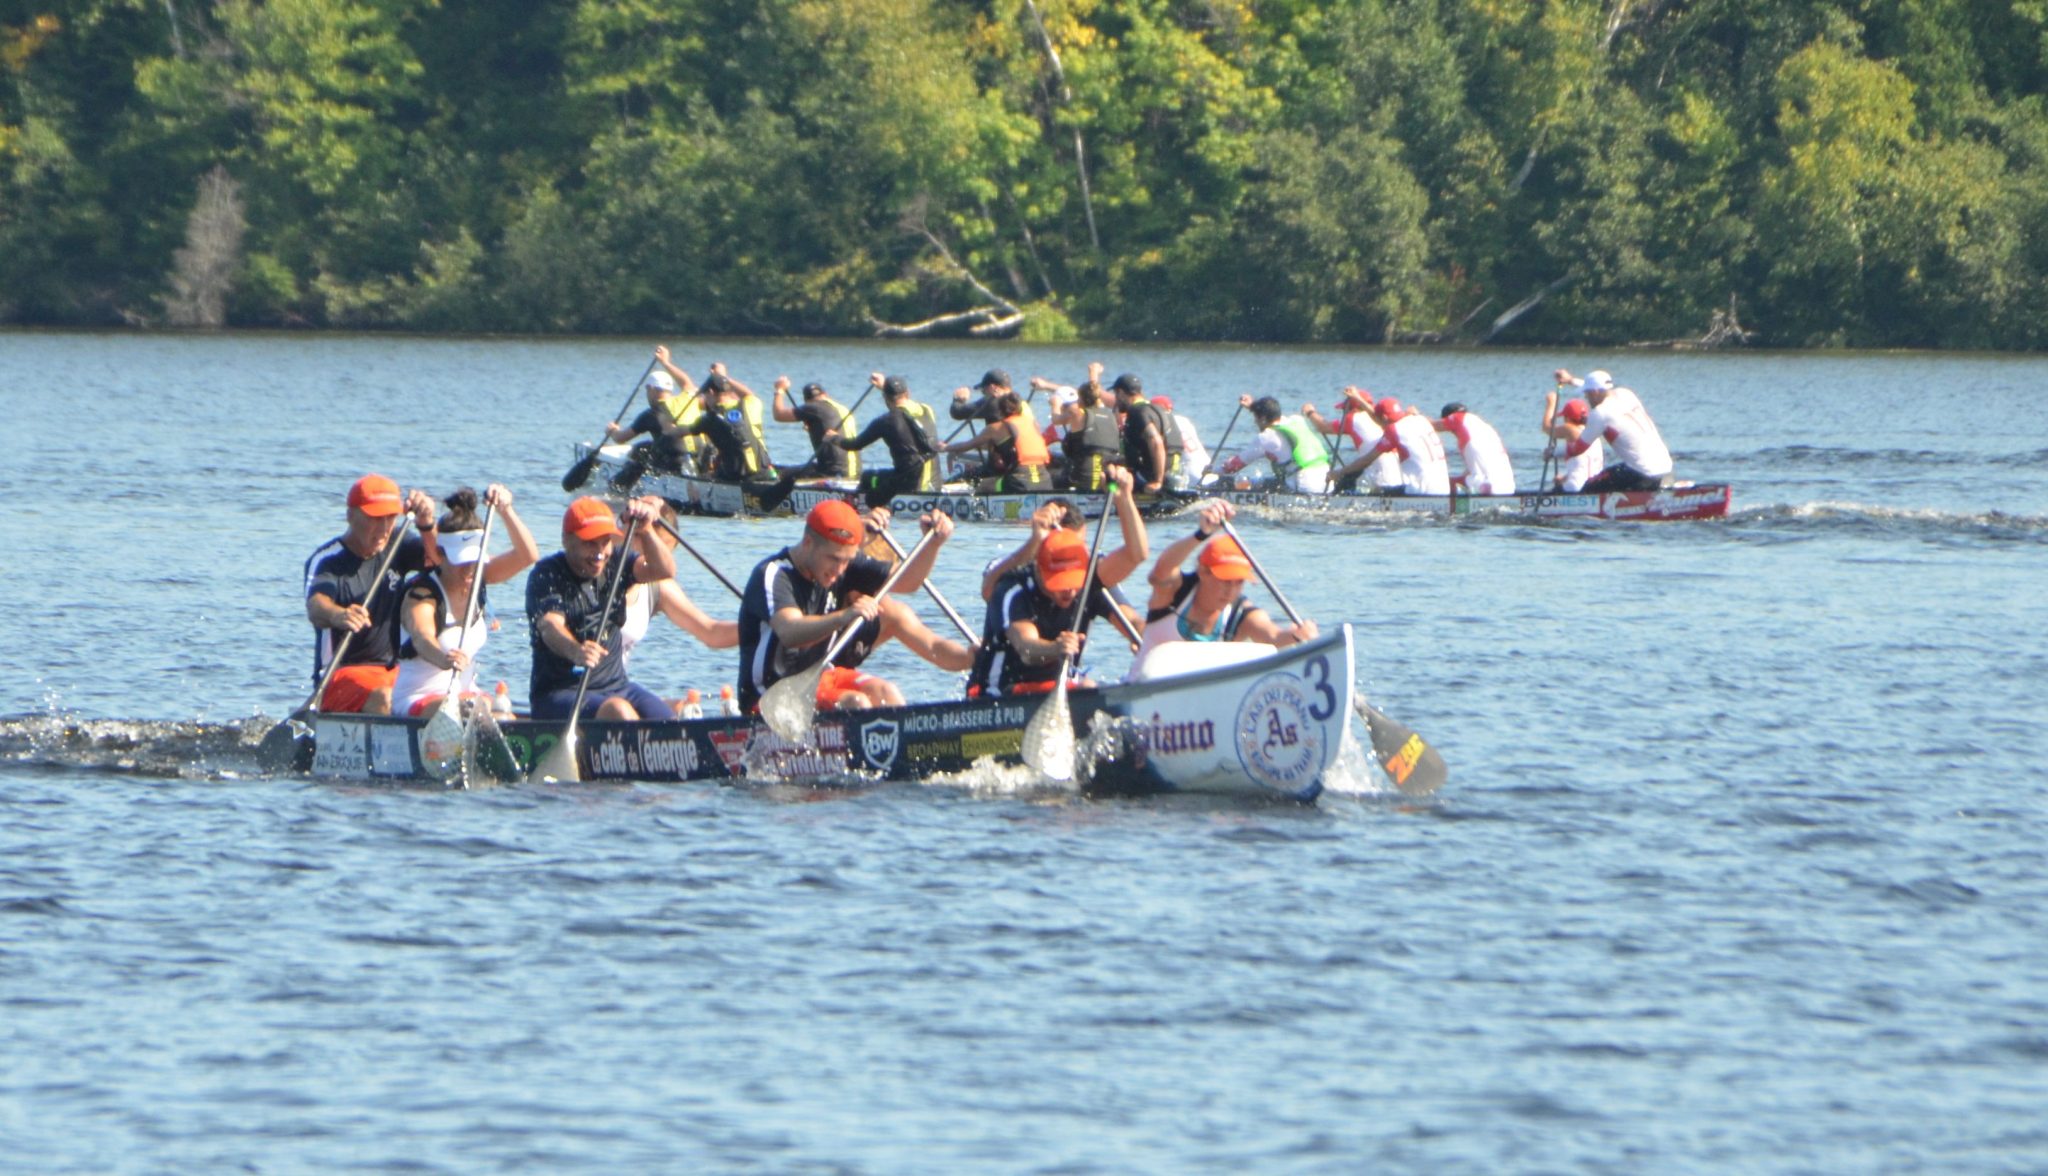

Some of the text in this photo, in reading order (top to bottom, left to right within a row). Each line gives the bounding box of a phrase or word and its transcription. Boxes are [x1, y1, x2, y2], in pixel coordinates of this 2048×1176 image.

[1304, 654, 1336, 722] 3
[818, 724, 844, 749] TIRE
[903, 709, 993, 733] MICRO-BRASSERIE
[1003, 706, 1025, 724] PUB
[1263, 707, 1298, 760] As
[600, 730, 627, 774] cité
[627, 743, 640, 774] de
[637, 728, 699, 780] l'énergie
